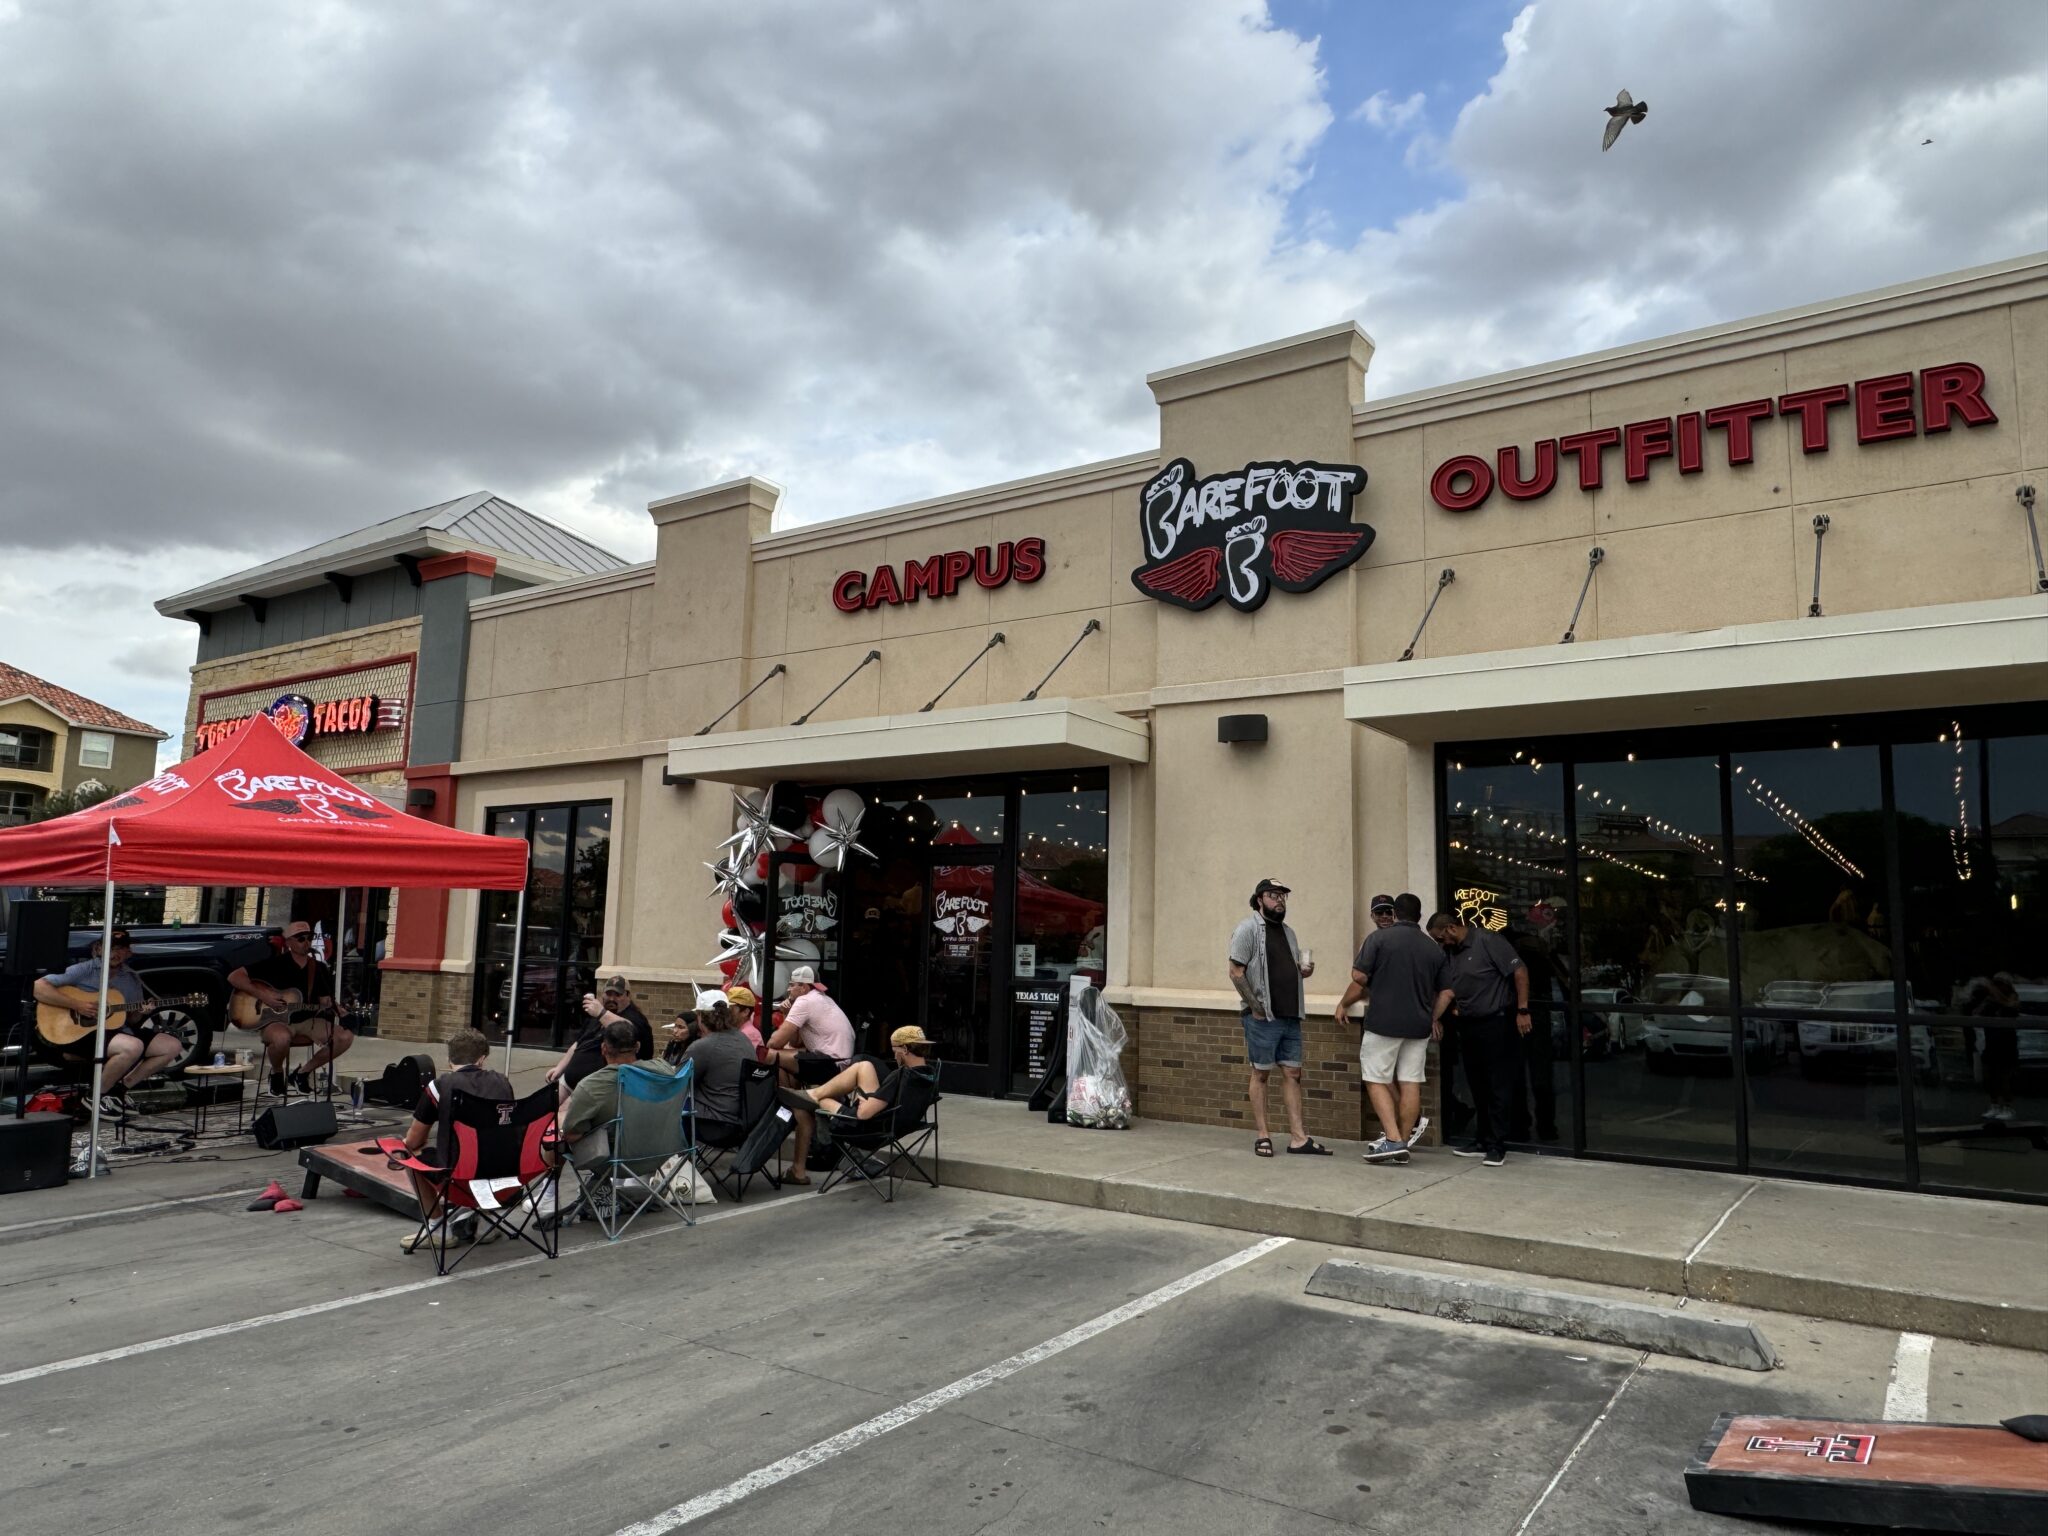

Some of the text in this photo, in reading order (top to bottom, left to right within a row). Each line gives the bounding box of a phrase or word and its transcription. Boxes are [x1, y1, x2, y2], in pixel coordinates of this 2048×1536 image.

[1430, 362, 1998, 512] OUTFITTER
[1146, 464, 1356, 559] BAREFOOT
[833, 537, 1046, 613] CAMPUS
[314, 696, 372, 734] TACOS
[214, 769, 375, 808] BAREFOOT
[936, 890, 988, 918] BAREFOOT
[1016, 992, 1060, 1002] TEXAS TECH
